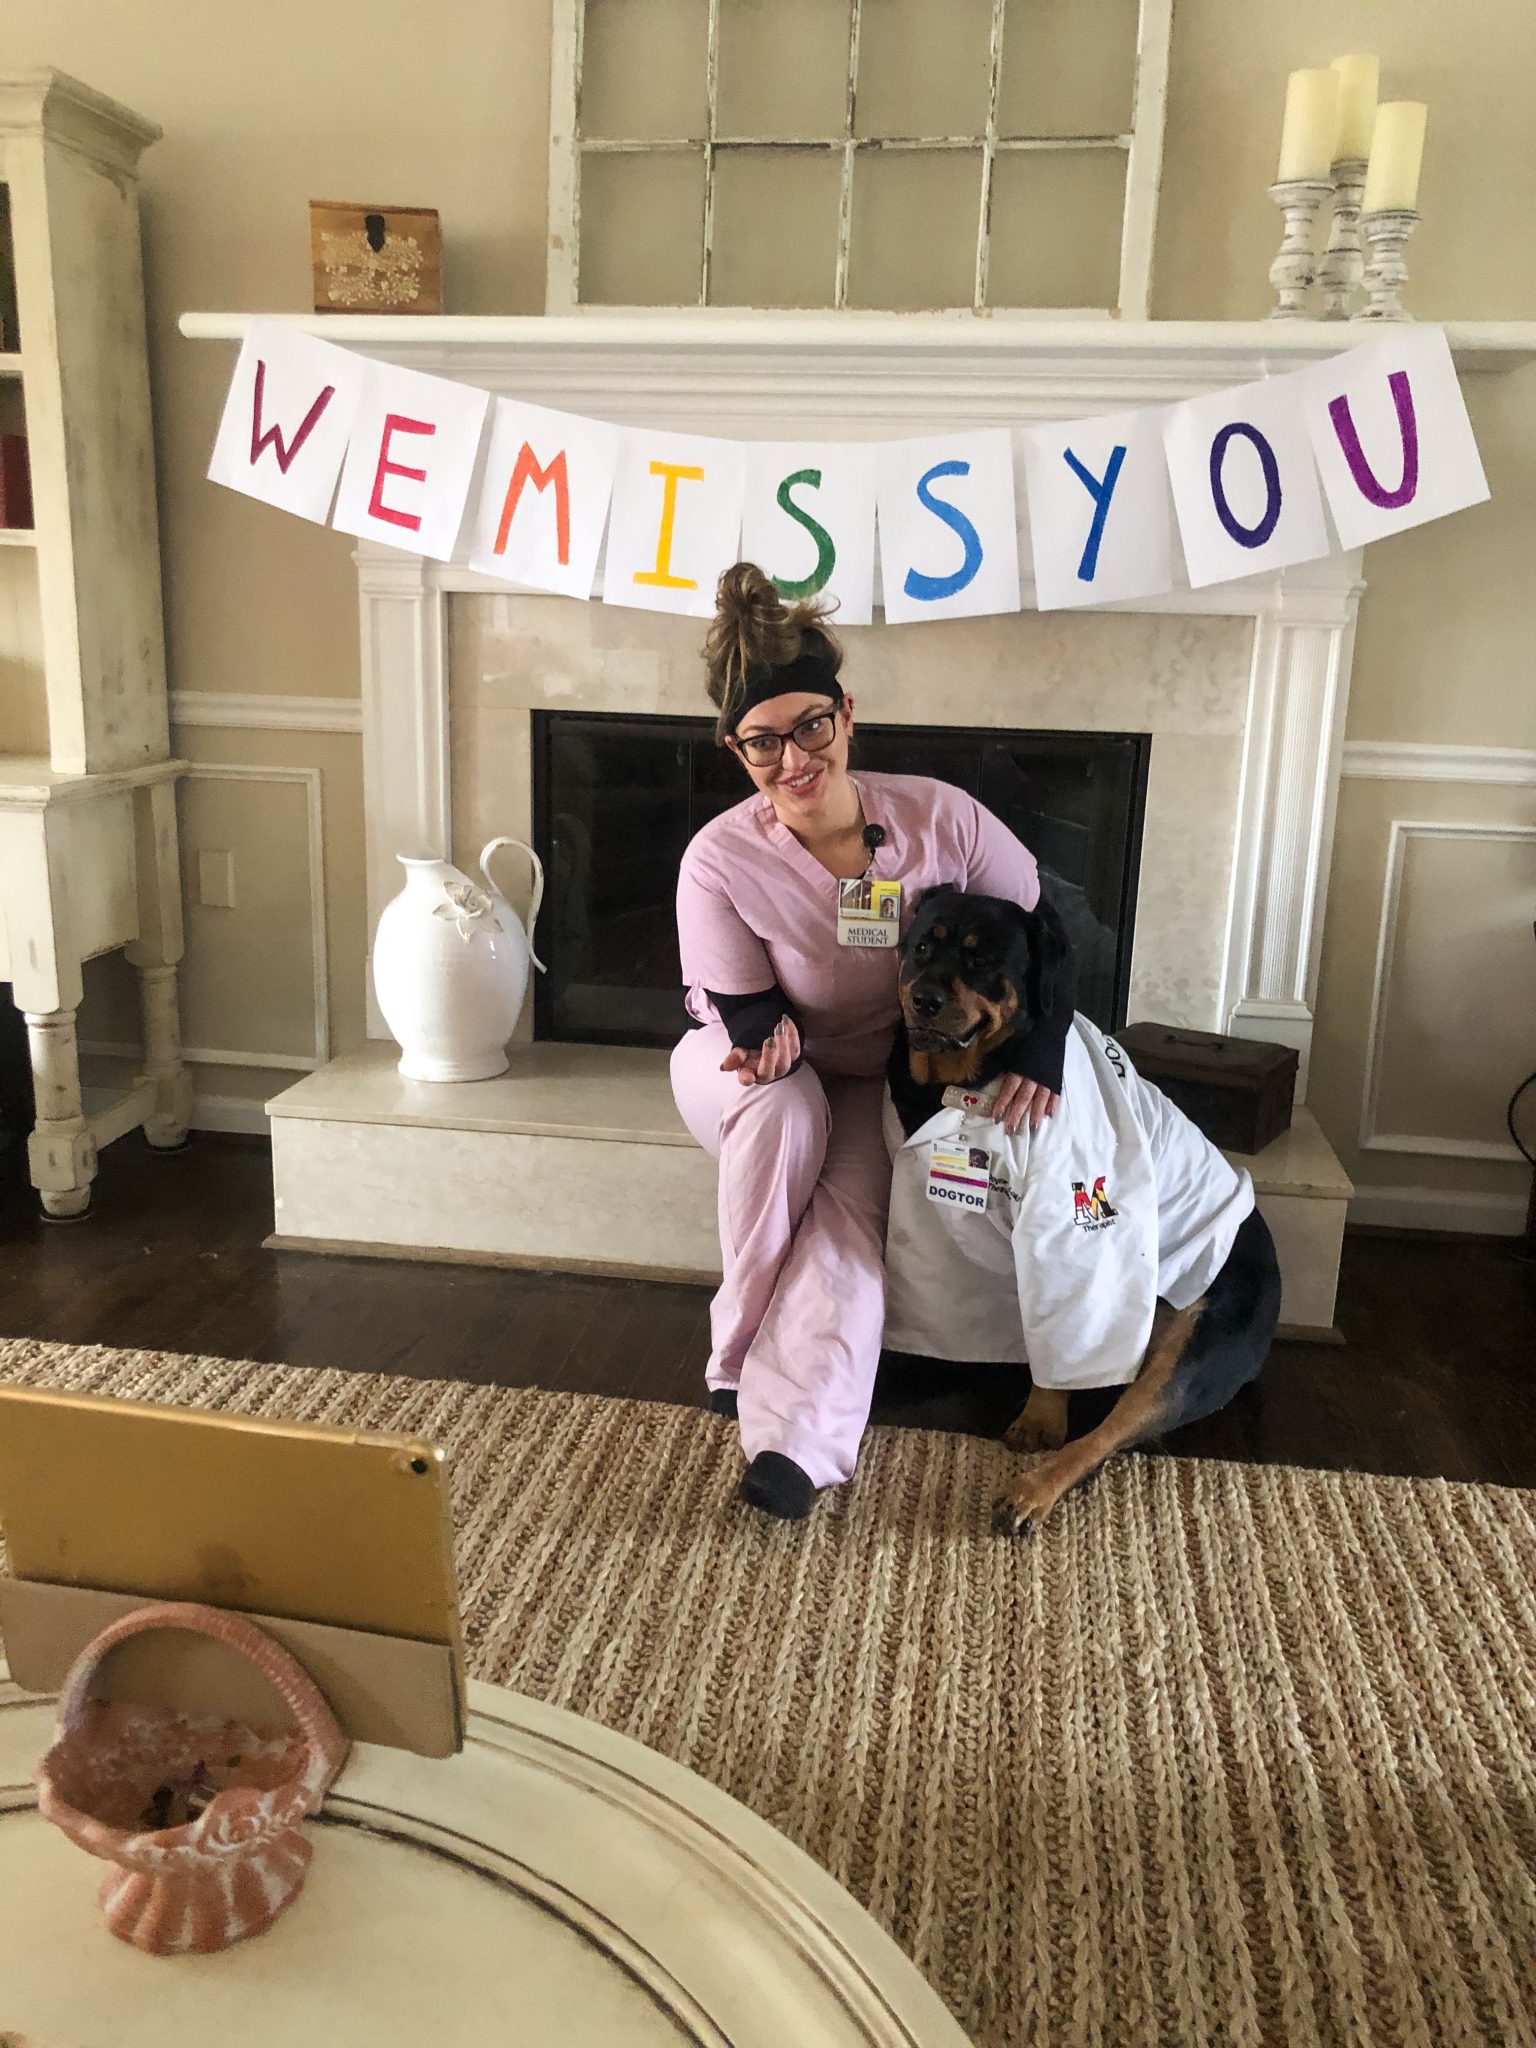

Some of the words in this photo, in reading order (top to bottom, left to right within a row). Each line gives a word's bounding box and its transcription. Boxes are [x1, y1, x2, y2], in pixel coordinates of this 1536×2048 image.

[250, 359, 436, 532] WE
[493, 440, 984, 602] MISS
[1062, 370, 1419, 583] YOU
[848, 927, 888, 937] MEDICAL
[847, 936, 888, 945] STUDENT
[929, 1185, 984, 1208] DOGTOR
